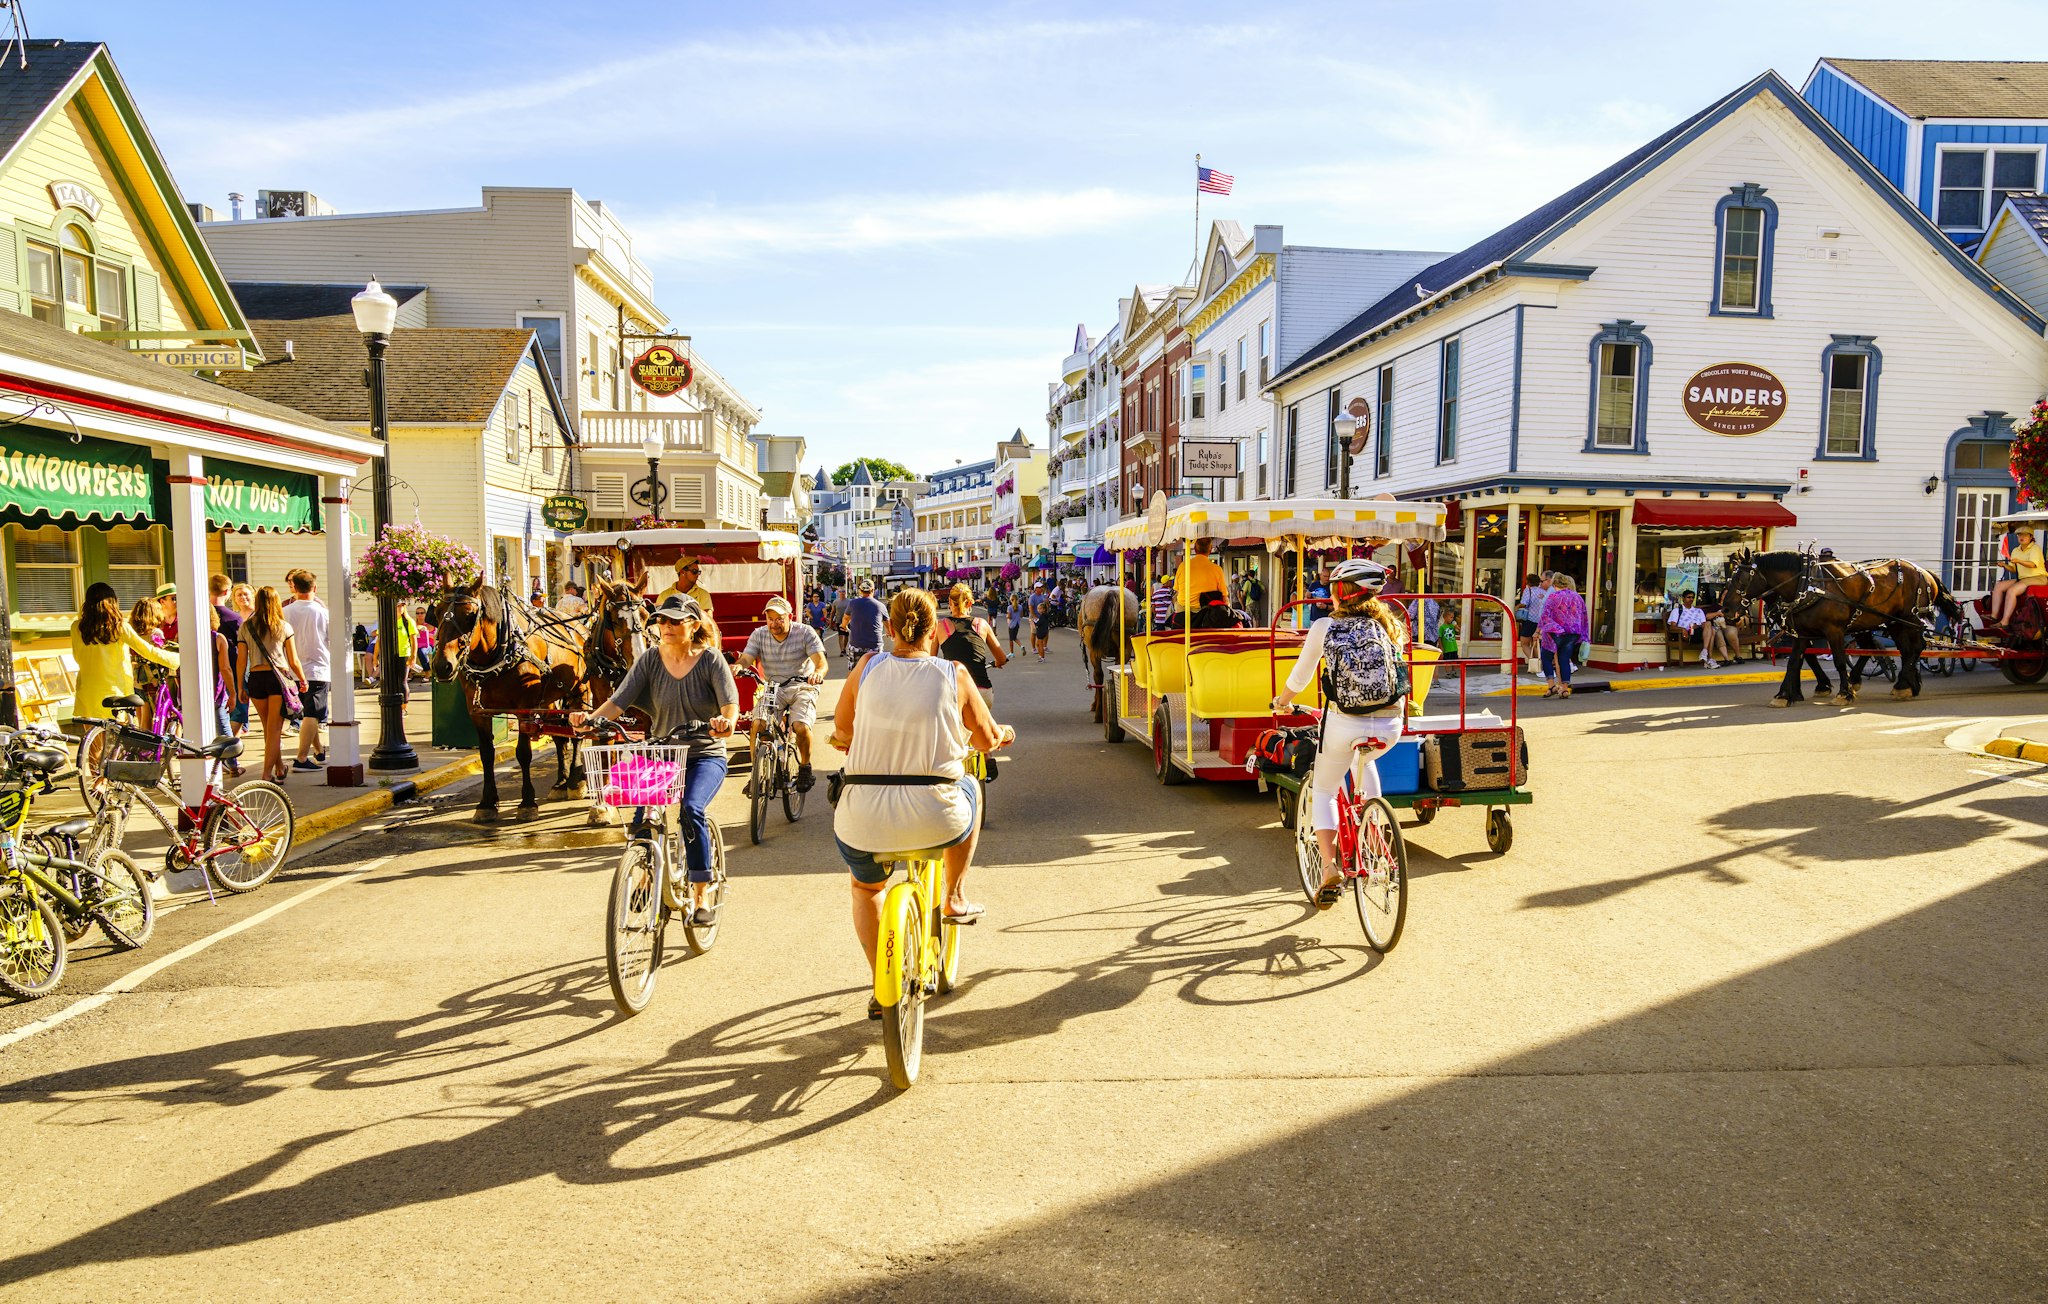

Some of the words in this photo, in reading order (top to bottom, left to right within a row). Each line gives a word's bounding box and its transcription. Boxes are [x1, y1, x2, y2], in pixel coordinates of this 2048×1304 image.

[57, 185, 96, 213] TAXI
[166, 352, 236, 366] OFFICE
[639, 365, 669, 376] SEABISCUIT
[1700, 369, 1730, 378] CHOCOLATE
[1750, 371, 1772, 381] SHARING
[1689, 386, 1783, 406] SANDERS
[1713, 422, 1736, 430] SINCE
[1198, 448, 1222, 462] Ryba's
[1187, 459, 1209, 471] Fudge
[1210, 460, 1233, 471] Shops
[206, 474, 245, 511] HOT
[250, 481, 290, 515] DOGS
[1680, 556, 1719, 565] SANDERS
